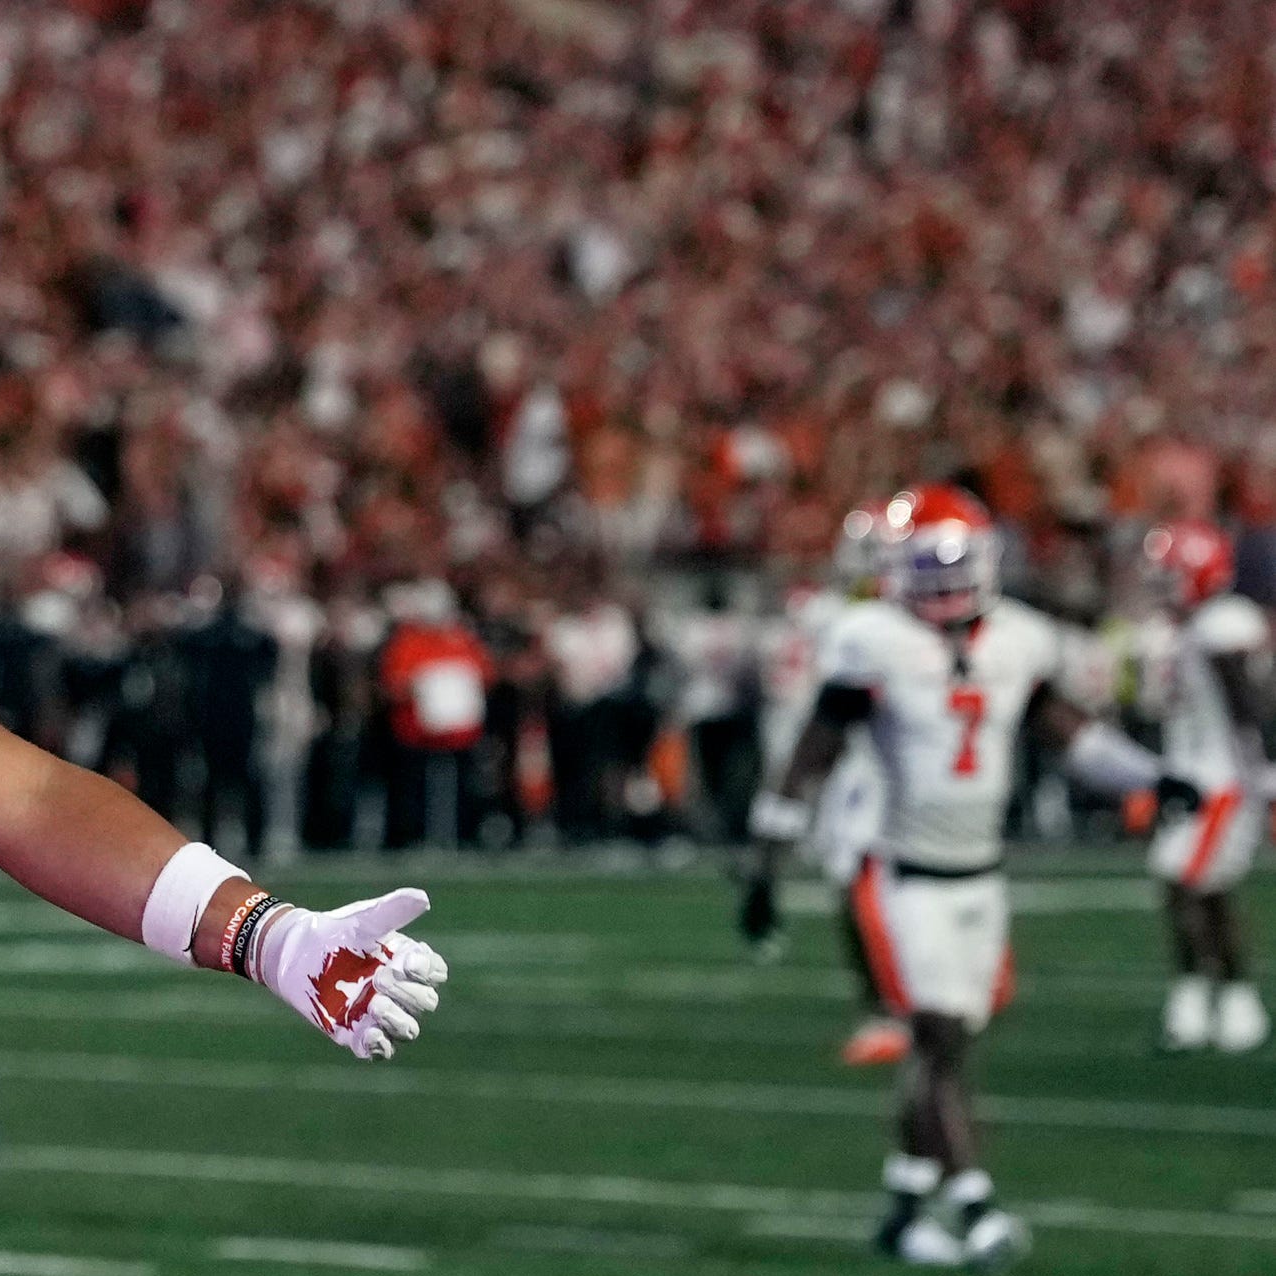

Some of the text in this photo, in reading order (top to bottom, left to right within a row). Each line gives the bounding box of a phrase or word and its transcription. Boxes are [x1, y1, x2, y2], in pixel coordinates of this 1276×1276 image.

[946, 687, 984, 778] 7
[245, 891, 268, 907] GOD
[255, 899, 273, 914] THE
[241, 912, 260, 937] FUCK
[234, 937, 245, 958] OUT
